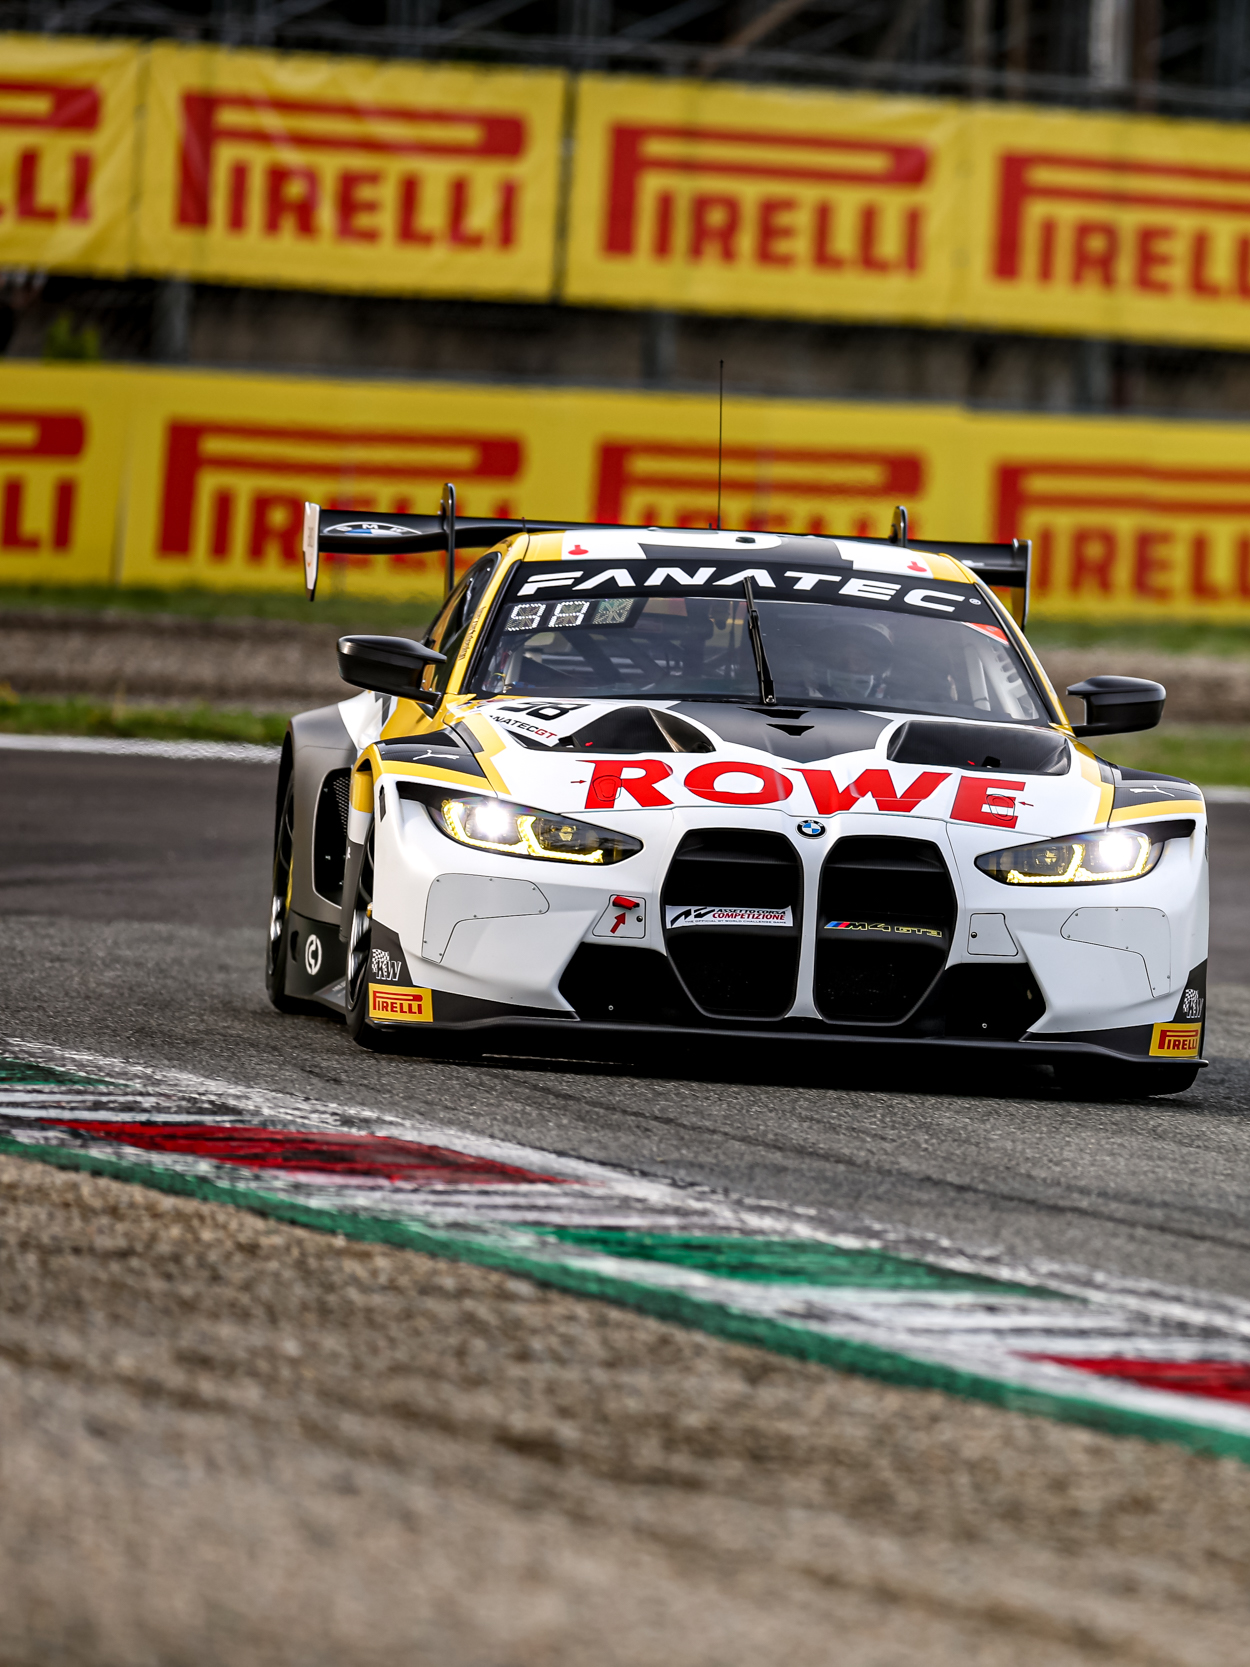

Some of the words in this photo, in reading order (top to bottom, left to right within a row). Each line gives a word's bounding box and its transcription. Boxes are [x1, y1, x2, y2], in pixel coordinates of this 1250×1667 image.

[175, 90, 528, 251] PIRELLI
[602, 122, 931, 274] PIRELLI
[158, 420, 525, 572] PIRL
[517, 566, 966, 613] FANATEC
[504, 600, 591, 632] 98
[575, 758, 1027, 830] ROWE
[712, 912, 785, 920] COMPETIZIONE
[894, 925, 943, 938] GT3
[372, 990, 424, 1015] PIRELLI
[1157, 1029, 1199, 1051] PIRELLI
